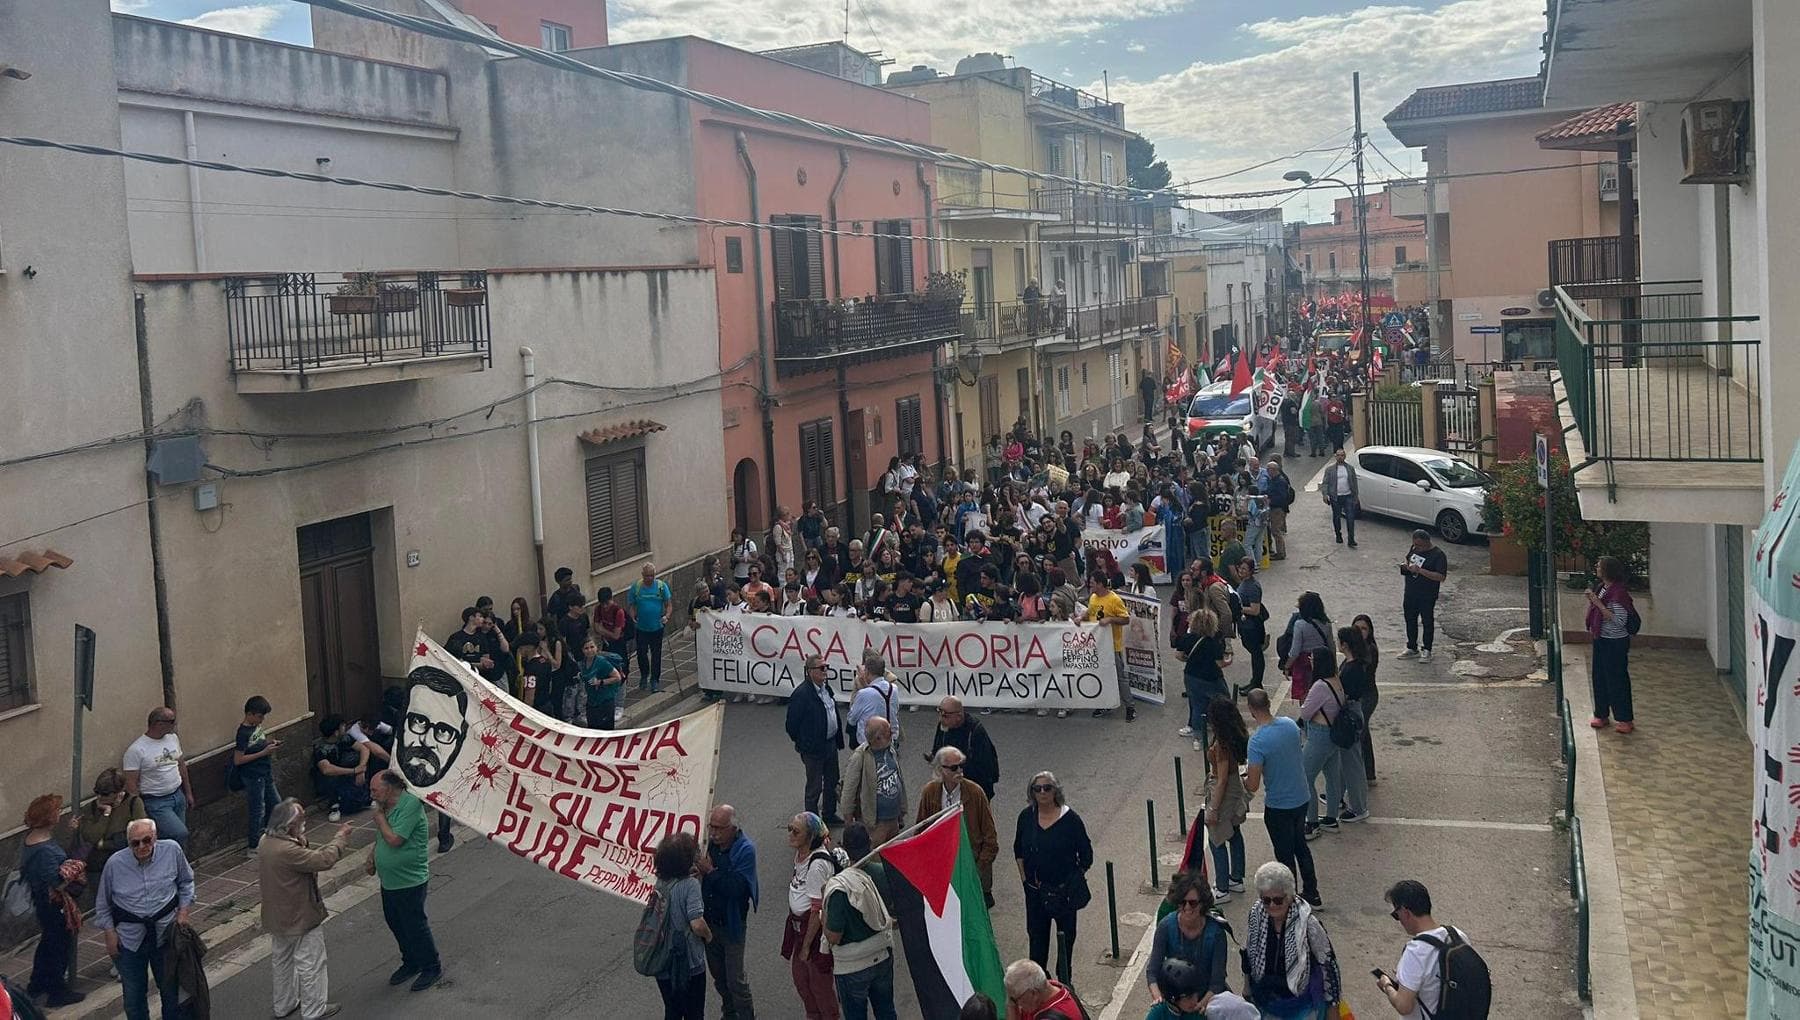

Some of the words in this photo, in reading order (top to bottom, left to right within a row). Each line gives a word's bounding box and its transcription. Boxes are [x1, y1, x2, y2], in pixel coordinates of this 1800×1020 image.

[1083, 536, 1128, 549] ensivo
[713, 620, 743, 632] CASA
[713, 641, 744, 650] PEPPINO
[751, 624, 849, 665] CASA
[862, 631, 1051, 669] MEMORIA
[1062, 631, 1096, 643] CASA
[712, 658, 795, 688] FELICIA
[825, 664, 937, 695] PENO
[946, 671, 1102, 699] IMPASTATO
[1062, 655, 1099, 663] PEPPINO
[508, 734, 641, 800] UCCIDE
[506, 772, 533, 814] IL
[550, 792, 700, 853] SILENZIO
[487, 808, 600, 880] PURE
